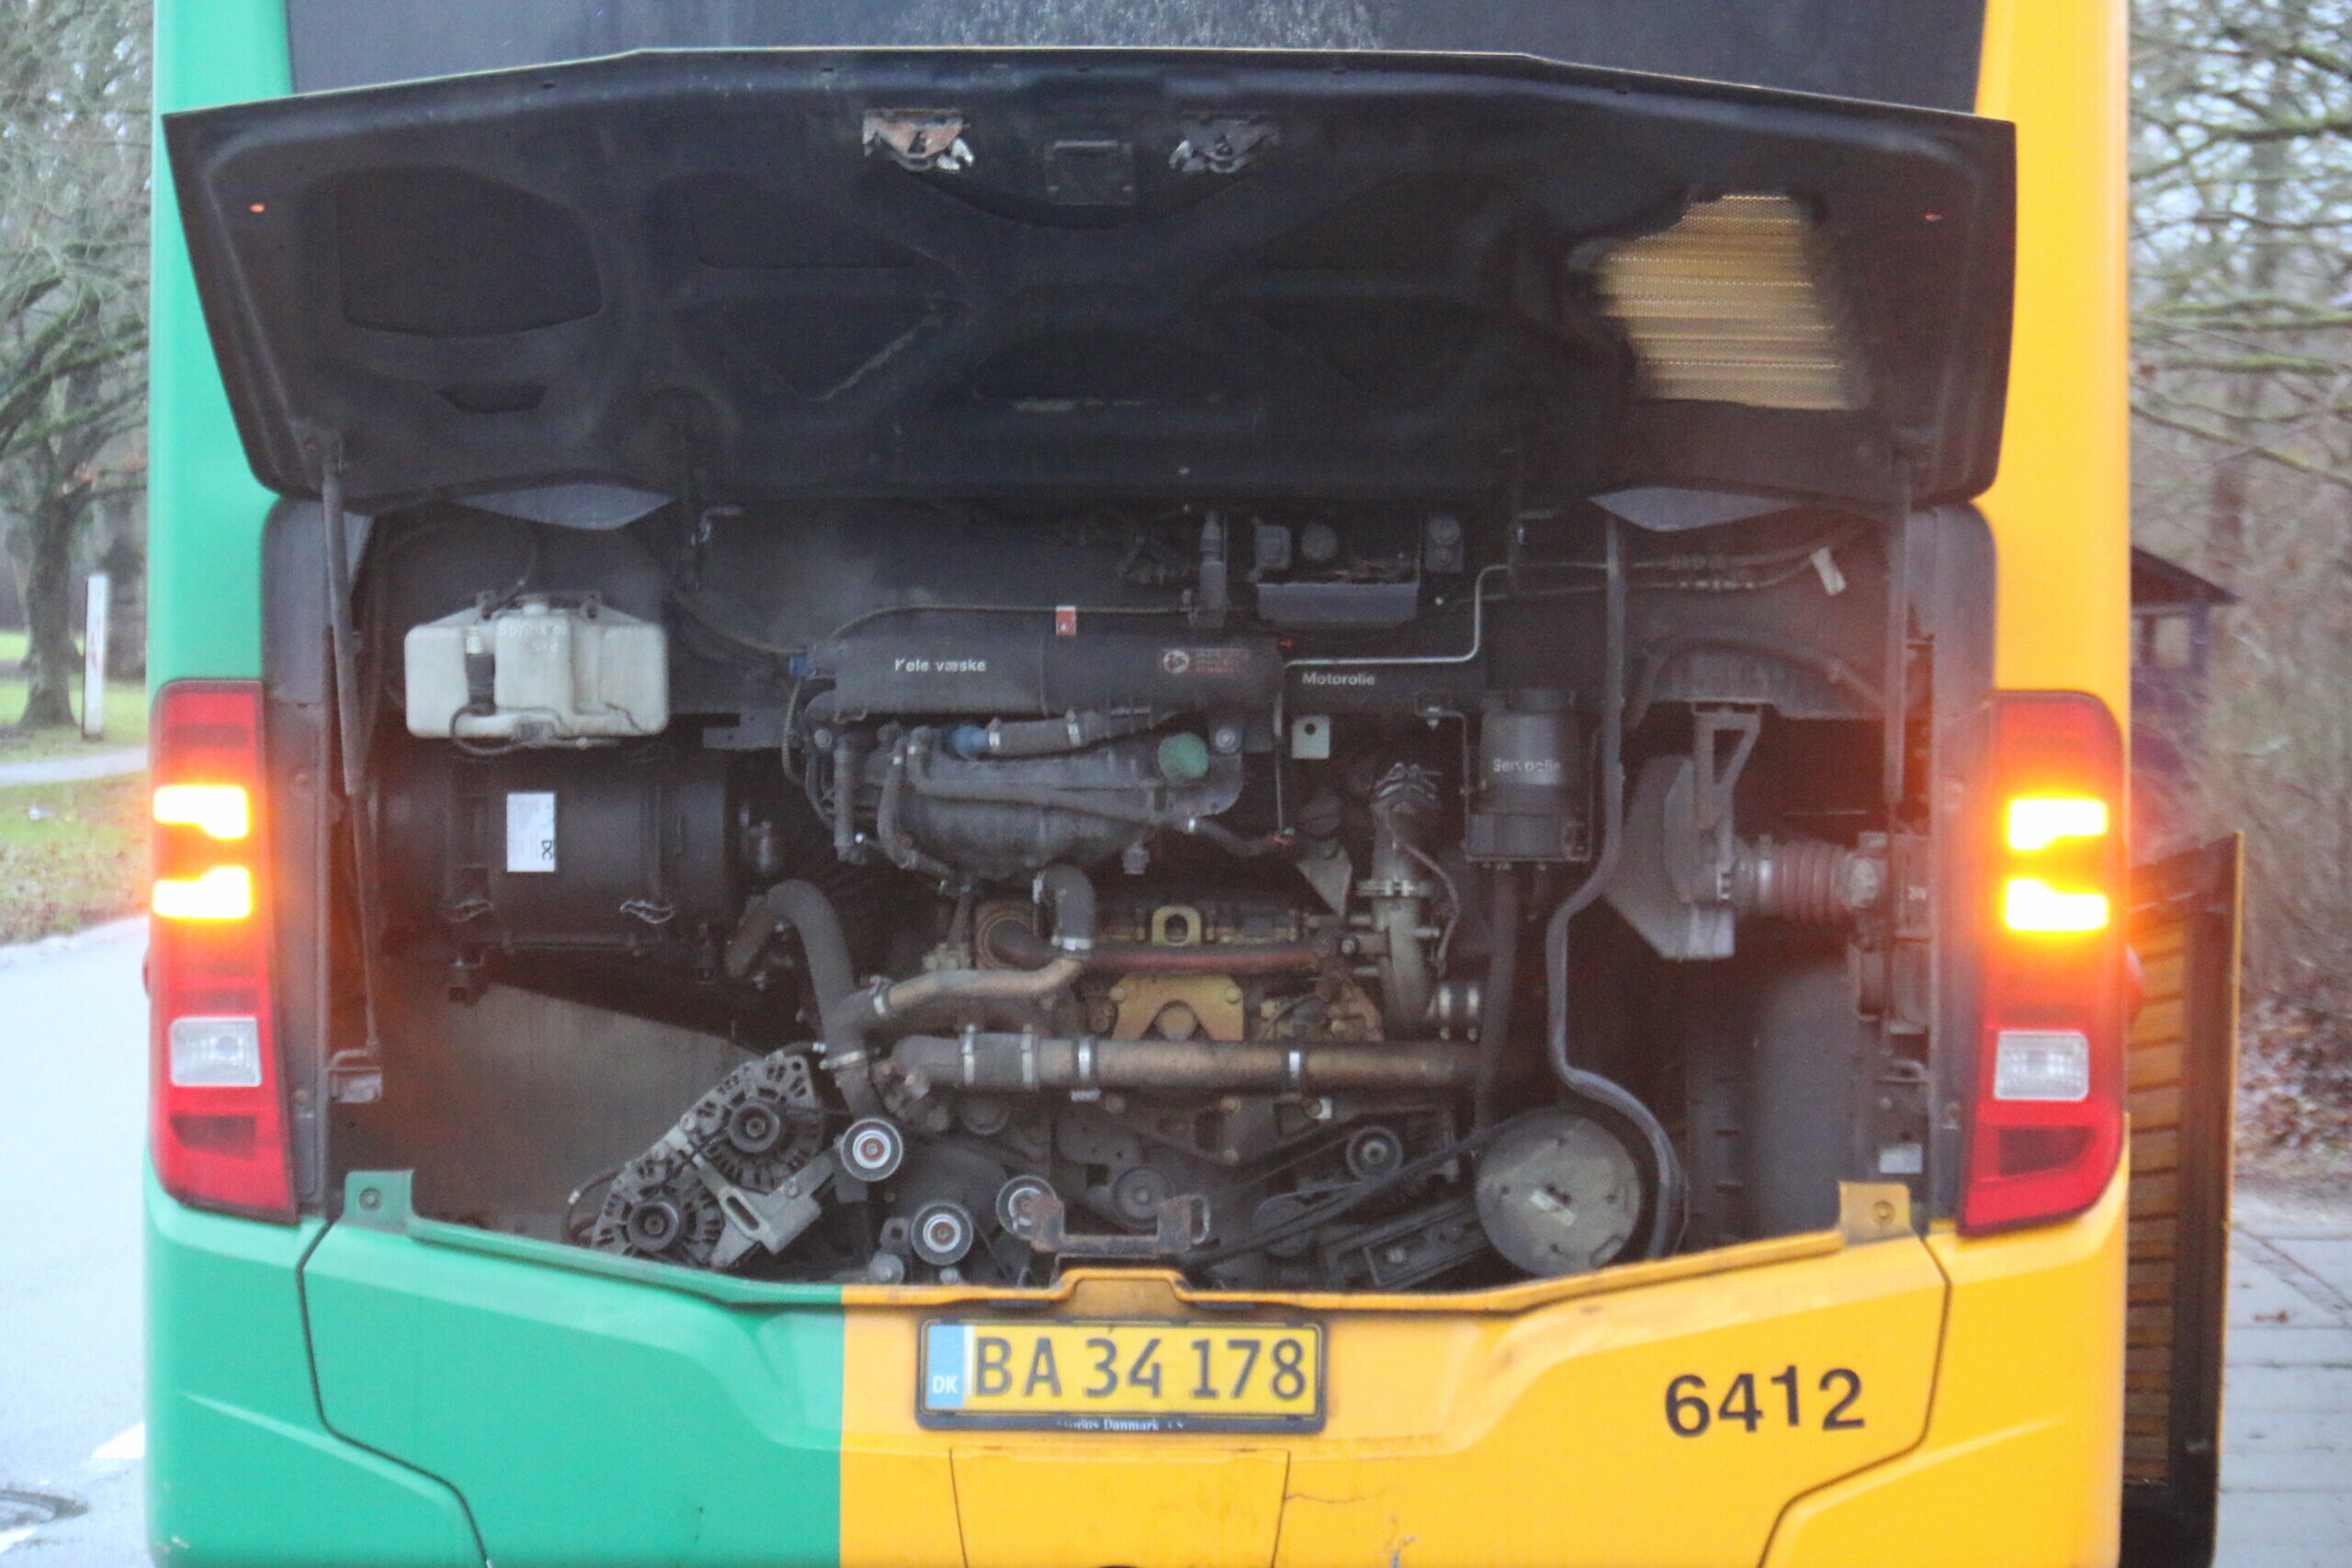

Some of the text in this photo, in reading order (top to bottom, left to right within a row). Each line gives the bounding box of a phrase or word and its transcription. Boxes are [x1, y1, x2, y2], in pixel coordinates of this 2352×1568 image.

[1302, 671, 1375, 685] Motorolie
[975, 1337, 1306, 1401] BA 34 178
[932, 1375, 958, 1394] DK
[1664, 1364, 1866, 1438] 6412
[1103, 1417, 1160, 1431] Danmark
